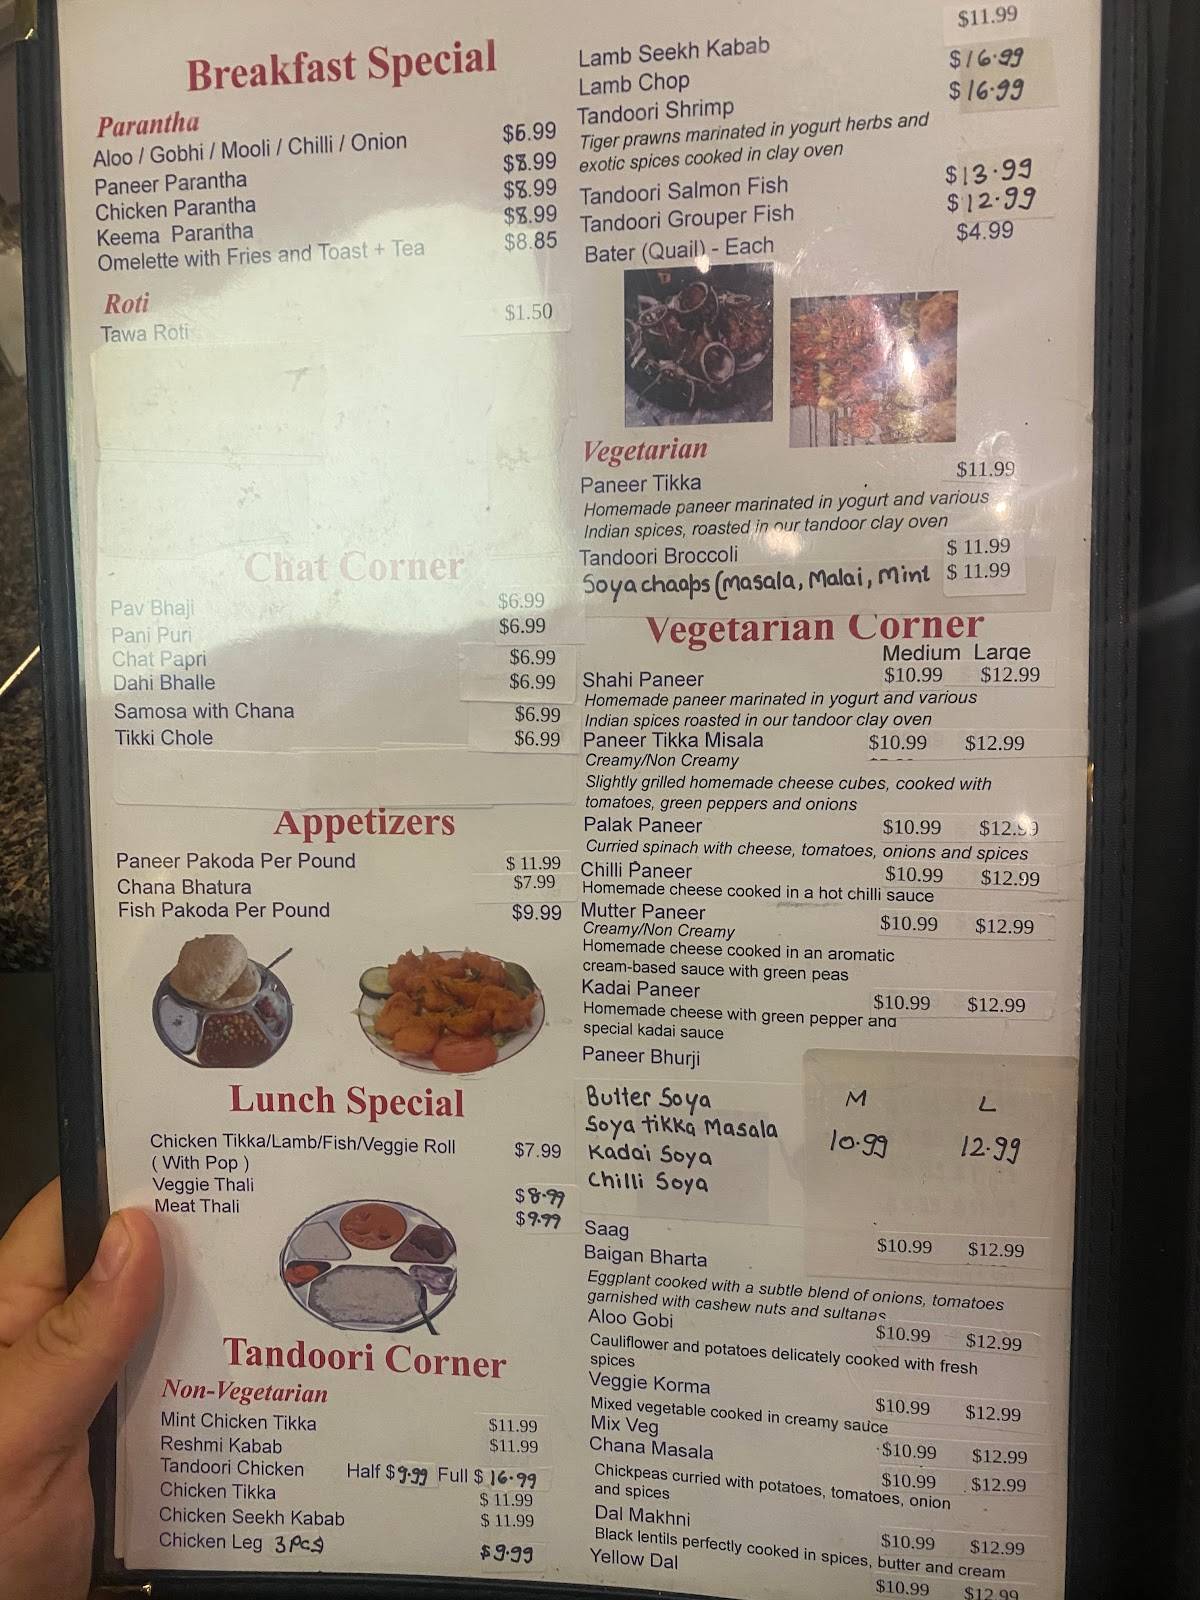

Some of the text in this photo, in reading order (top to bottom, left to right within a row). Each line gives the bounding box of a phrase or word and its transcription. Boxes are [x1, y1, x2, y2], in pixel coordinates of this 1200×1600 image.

[957, 5, 1018, 28] $11.99
[578, 34, 770, 68] Lamb Seekh Kabab
[186, 37, 497, 92] Breakfast Special
[578, 71, 690, 96] Lamb Chop
[575, 98, 734, 125] Tandoori Shrimp
[96, 109, 199, 138] Parantha
[579, 110, 930, 153] Tiger prawns marinated in yogurt herbs and
[94, 169, 247, 196] Paneer Parantha
[578, 174, 788, 206] Tandoori Salmon Fish
[94, 194, 256, 222] Chicken Parantha
[578, 202, 794, 233] Tandoori Grouper Fish
[96, 221, 254, 247] Keema Parantha
[503, 229, 558, 252] $8.85
[955, 219, 1014, 243] $4.99
[96, 238, 425, 272] Omelette with Fries and Toast + Tea
[103, 290, 150, 315] Roti
[504, 301, 553, 322] $1.50
[99, 321, 189, 343] Tawa Roti
[584, 436, 708, 468] Vegetarian
[955, 460, 1015, 478] $11.99
[580, 472, 702, 495] Paneer Tikka
[243, 549, 465, 583] Chat Corner
[577, 544, 738, 567] Tandoori Broccoli
[110, 597, 195, 620] Pav Bhaji
[497, 591, 545, 611] $6.99
[110, 625, 192, 644] Pani Puri
[498, 616, 546, 636] $6.99
[111, 649, 207, 672] Chat Papri
[508, 647, 556, 666] $6.99
[113, 673, 216, 691] Dahi Bhalle
[508, 671, 556, 690] $6.99
[581, 670, 705, 688] Shahi Paneer
[883, 665, 943, 684] $10.99
[979, 665, 1040, 684] $12.99
[113, 701, 295, 720] Samosa with Chana
[514, 704, 561, 723] $6.99
[113, 728, 214, 746] Tikki Chole
[513, 729, 561, 748] $6.99
[582, 730, 764, 748] Paneer Tikka Misala
[867, 733, 927, 751] $10.99
[964, 734, 1025, 752] $12.99
[272, 806, 455, 844] Appetizers
[115, 851, 356, 869] Paneer Pakoda Per Pound
[116, 877, 252, 895] Chana Bhatura
[512, 873, 556, 890] $7.99
[117, 900, 330, 918] Fish Pakoda Per Pound
[511, 902, 562, 922] $9.99
[581, 977, 701, 998] Kadai Paneer
[872, 993, 931, 1011] $10.99
[966, 995, 1026, 1013] $12.99
[227, 1083, 465, 1122] Lunch Special
[585, 1083, 712, 1113] Butter Soya
[149, 1132, 455, 1156] Chicken Tikka/Lamb/Fish/Veggie Roll
[513, 1140, 562, 1159] $7.99
[151, 1176, 254, 1195] Veggie Thali
[587, 1169, 709, 1196] Chilli Soya
[153, 1197, 240, 1214] Meat Thali
[583, 1243, 708, 1268] Baigan Bharta
[586, 1307, 673, 1329] Aloo Gobi
[222, 1336, 507, 1379] Tandoori Corner
[589, 1331, 978, 1375] Cauliflower and potatoes delicately cooked with fresh
[160, 1378, 328, 1406] Non-Vegetarian
[587, 1369, 711, 1395] Veggie Korma
[160, 1410, 317, 1431] Mint Chicken Tikka
[488, 1417, 538, 1433] $11.99
[160, 1434, 282, 1454] Reshmi Kabab
[488, 1437, 539, 1453] $11.99
[588, 1435, 714, 1461] Chana Masala
[159, 1456, 304, 1477] Tandoori Chicken
[346, 1462, 381, 1479] Half
[437, 1466, 468, 1483] Full
[159, 1480, 276, 1500] Chicken Tikka
[158, 1505, 345, 1526] Chicken Seekh Kabab
[594, 1503, 690, 1528] Dal Makhni
[158, 1530, 263, 1554] Chicken Leg
[589, 1546, 678, 1570] Yellow Dal
